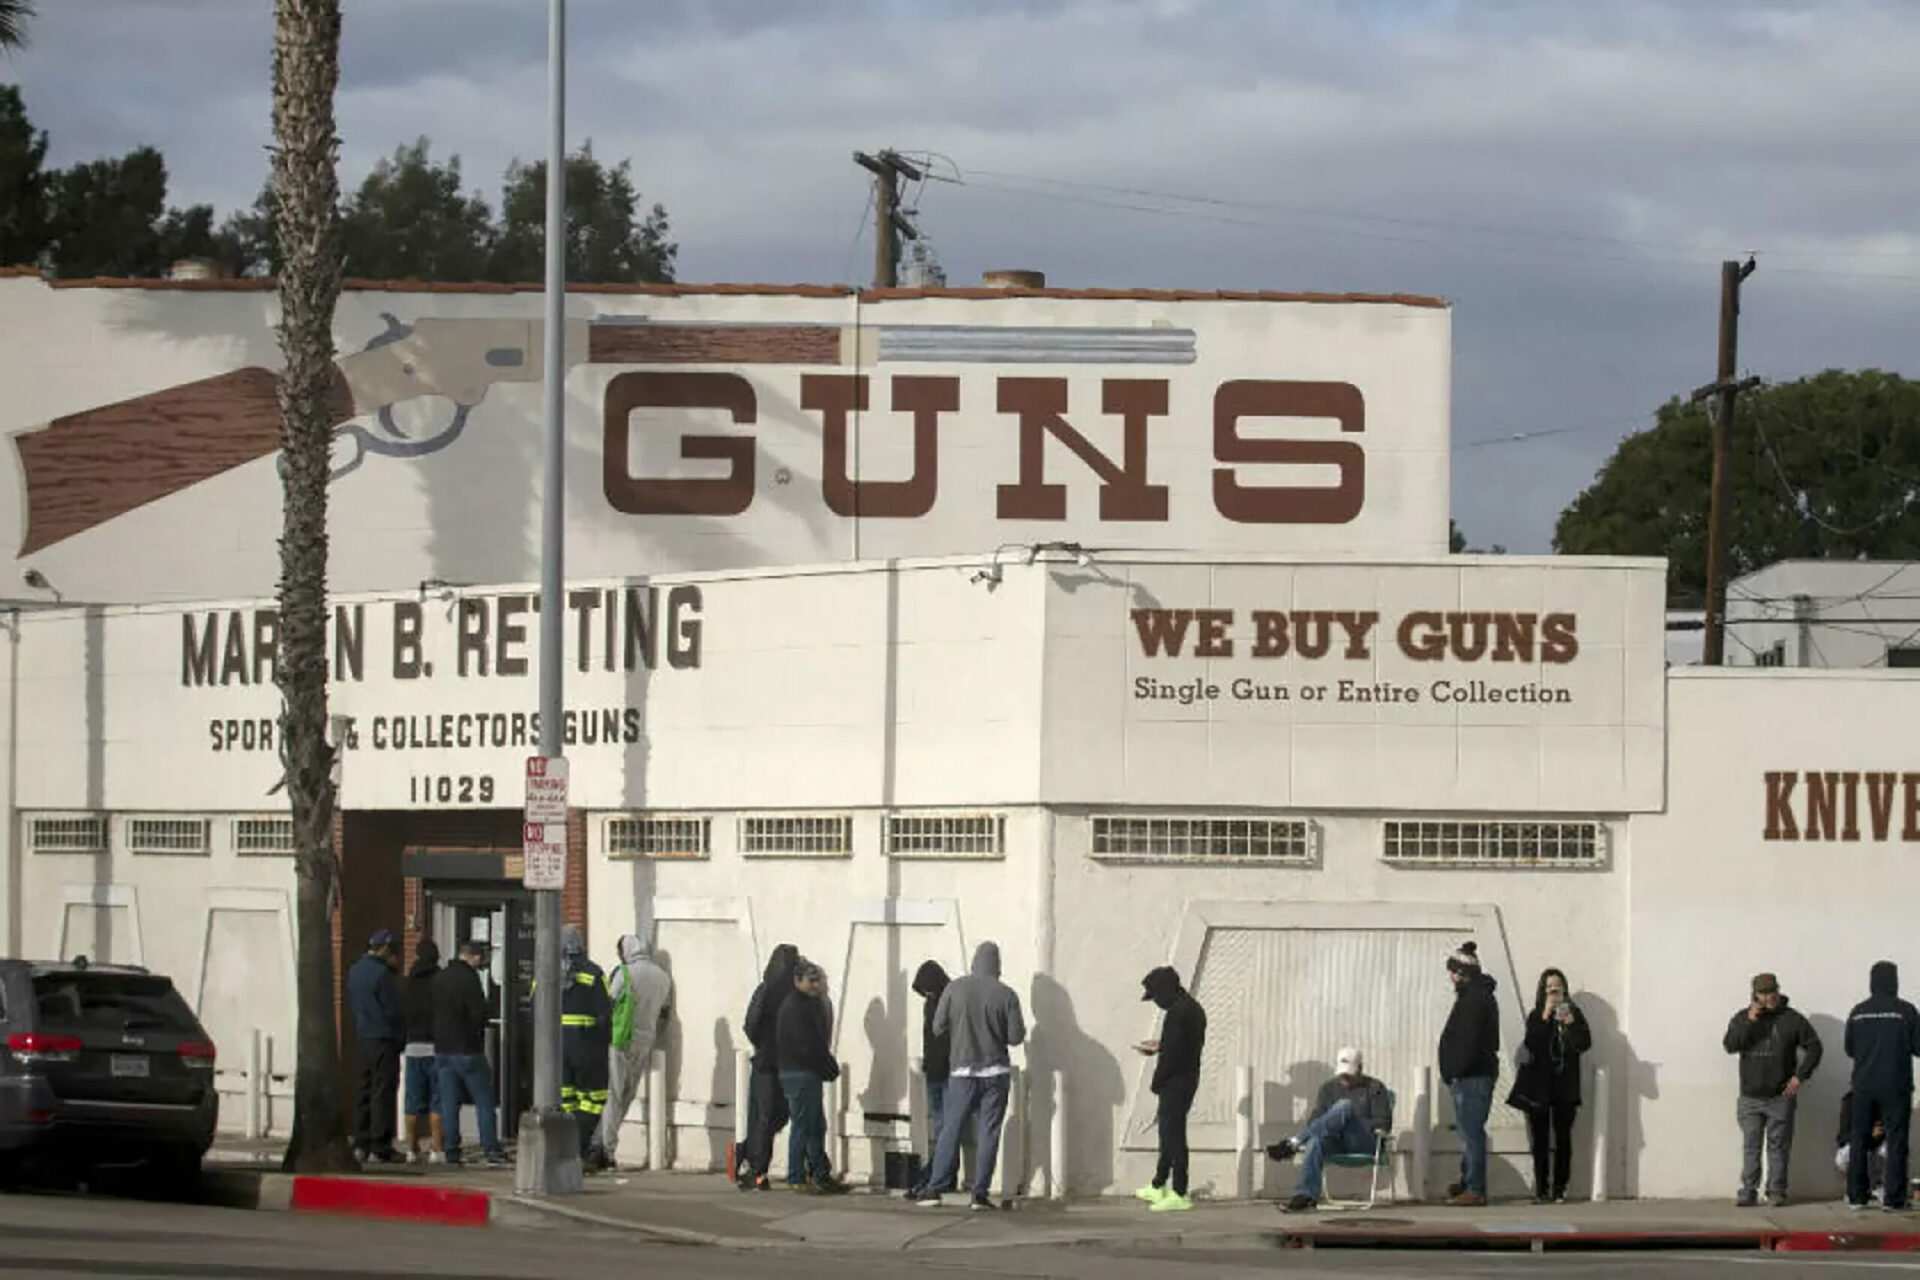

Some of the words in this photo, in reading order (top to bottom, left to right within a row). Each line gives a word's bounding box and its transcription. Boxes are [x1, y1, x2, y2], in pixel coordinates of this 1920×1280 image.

[604, 371, 1365, 523] GUNS
[182, 604, 363, 687] MARN
[393, 600, 433, 679] B.
[1130, 608, 1233, 657] WE
[1252, 610, 1379, 660] BUY
[1397, 611, 1579, 664] GUNS
[1135, 677, 1220, 704] Single
[1232, 678, 1289, 700] Gun
[1300, 685, 1327, 700] or
[1338, 680, 1420, 702] Entire
[1431, 680, 1572, 703] Collection
[372, 711, 542, 750] COLLECTORS
[563, 708, 642, 746] GUNS
[411, 776, 495, 803] 11029
